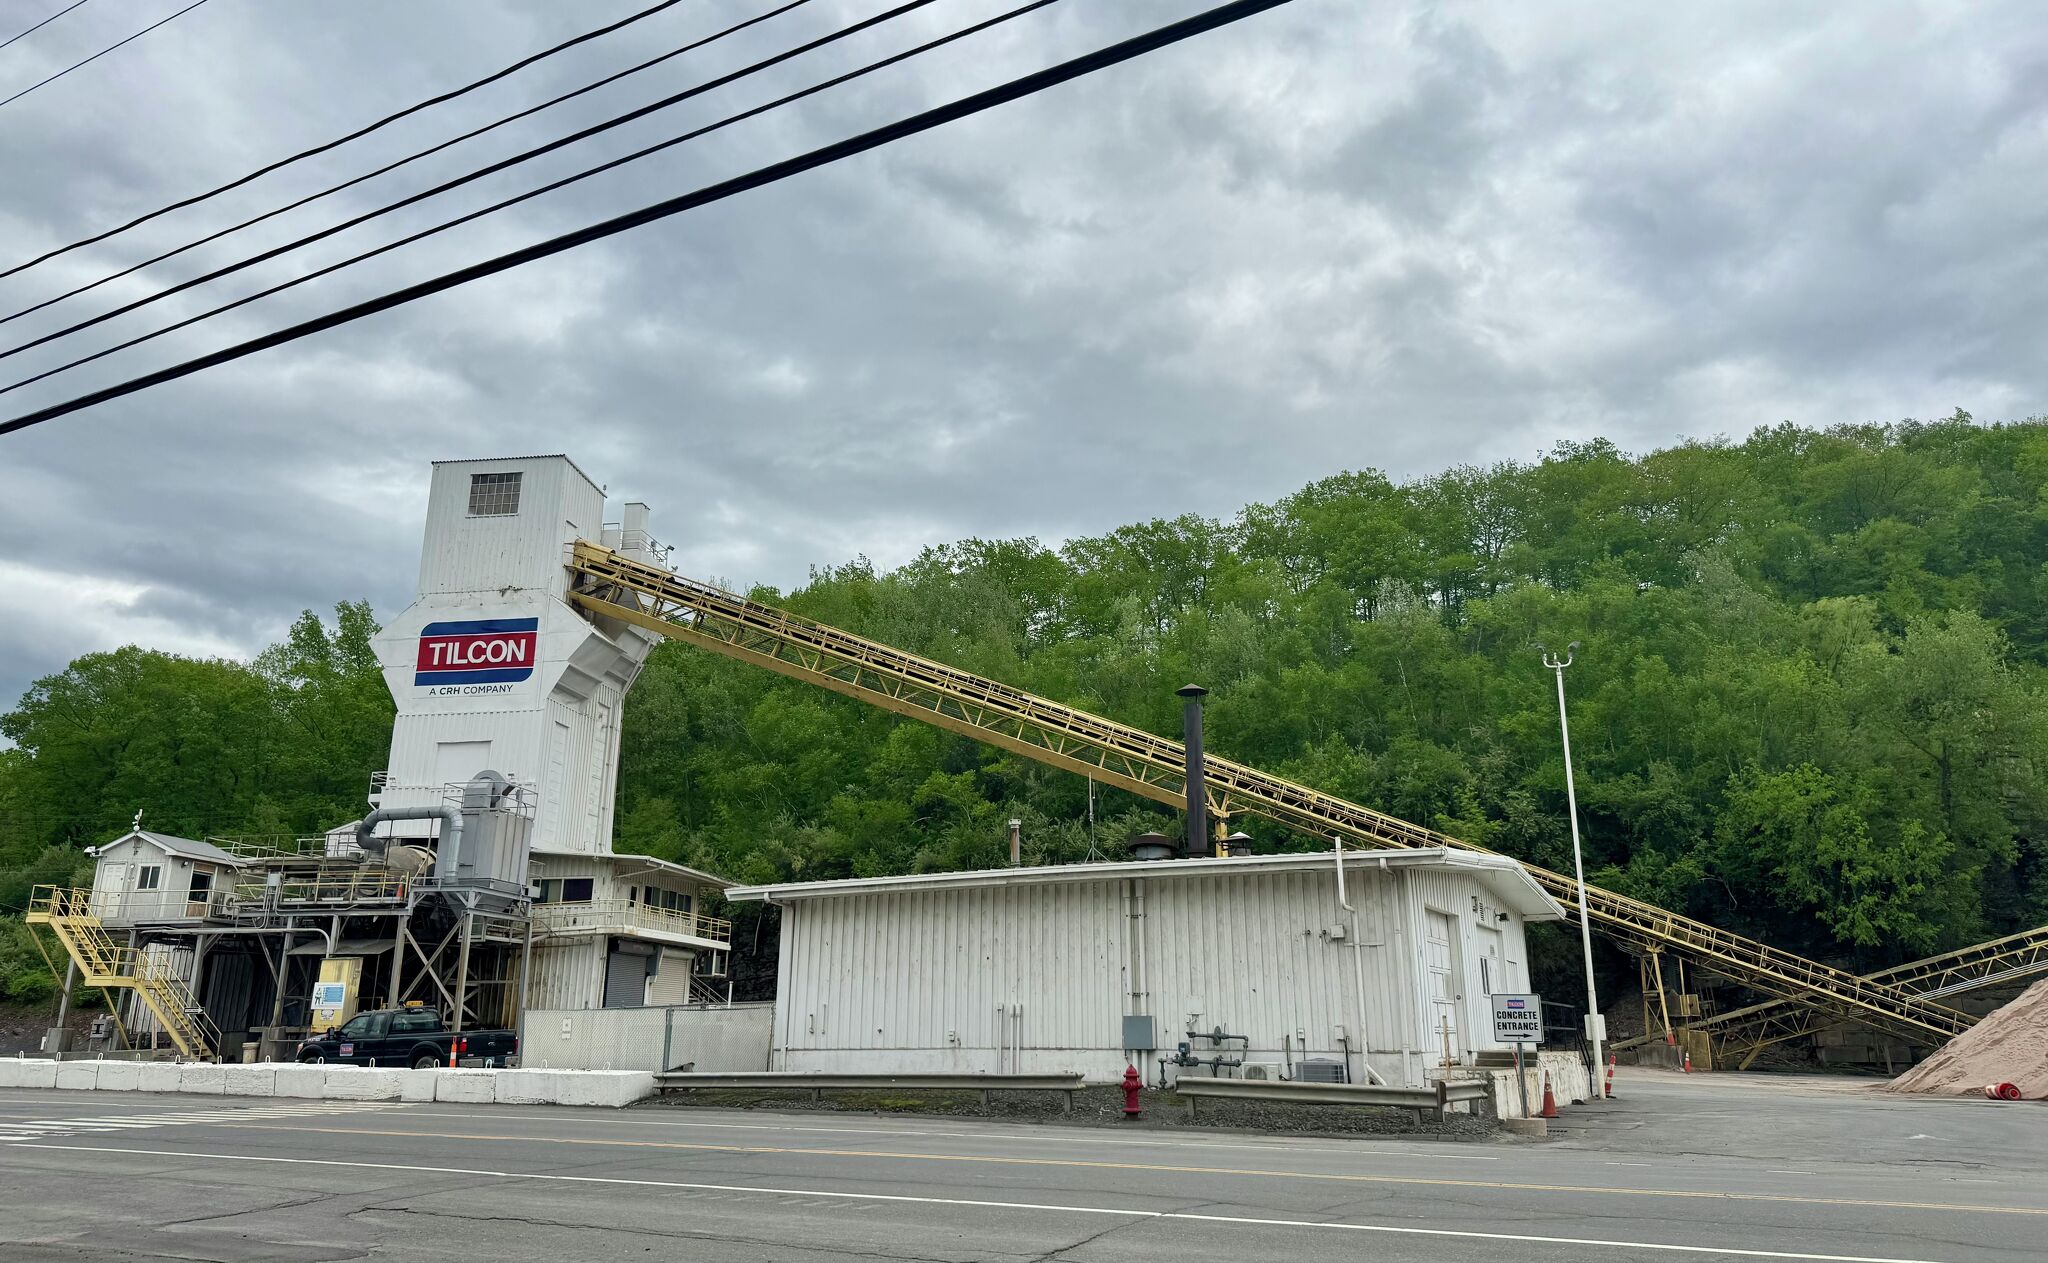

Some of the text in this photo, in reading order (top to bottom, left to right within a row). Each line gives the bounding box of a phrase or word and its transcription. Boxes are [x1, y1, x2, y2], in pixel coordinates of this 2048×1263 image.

[429, 639, 526, 666] TILCON
[439, 686, 460, 695] CRH
[463, 684, 514, 694] COMPANY
[1496, 1011, 1538, 1019] CONCRETE
[1497, 1022, 1539, 1030] ENTRANCE
